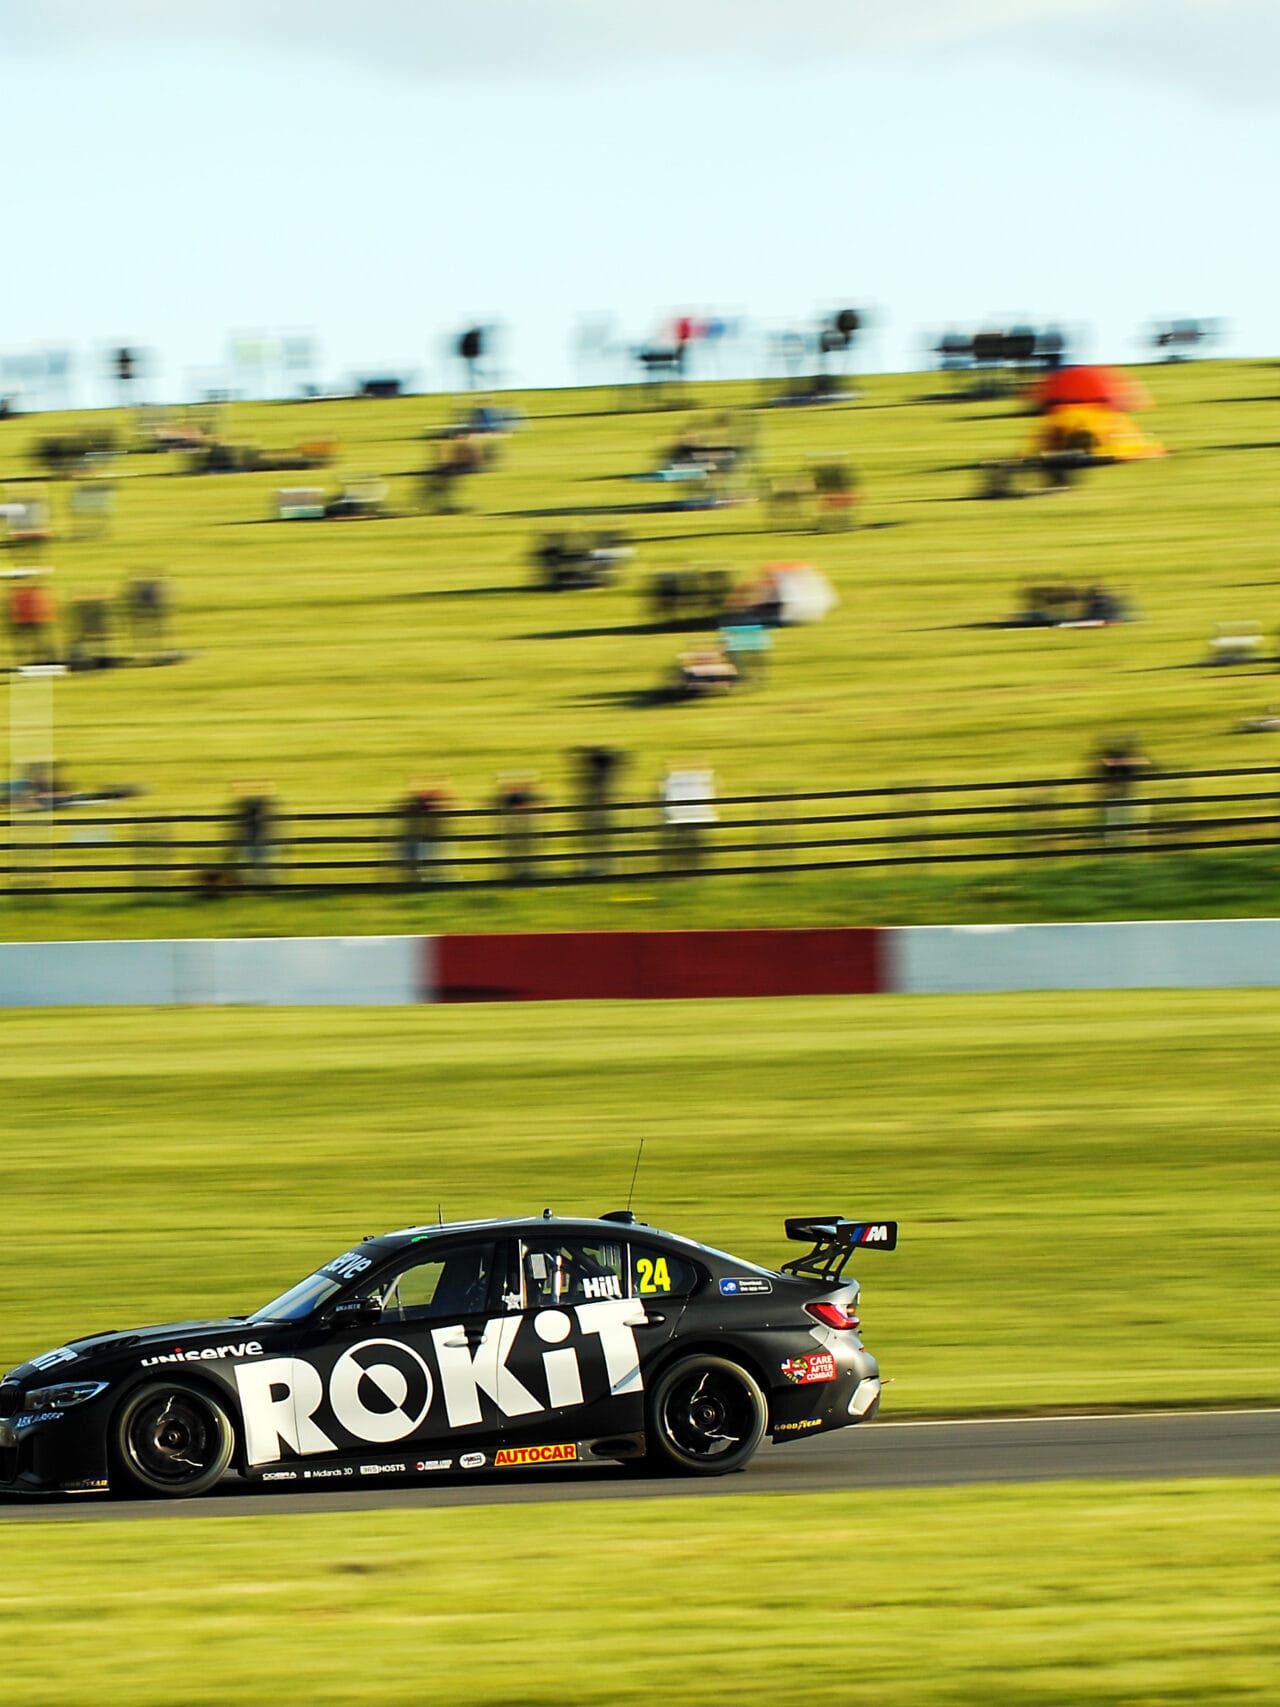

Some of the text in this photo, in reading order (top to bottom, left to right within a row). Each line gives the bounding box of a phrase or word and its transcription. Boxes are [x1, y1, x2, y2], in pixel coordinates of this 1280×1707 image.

[866, 1226, 888, 1241] M
[637, 1257, 671, 1294] 24
[583, 1275, 622, 1299] Hill
[810, 1355, 833, 1366] CARE
[811, 1364, 834, 1373] AFTER
[234, 1299, 646, 1466] ROKiT
[806, 1371, 834, 1381] COMBAT
[774, 1418, 823, 1431] GOODYEAR
[496, 1445, 575, 1465] AUTOCAR
[343, 1467, 354, 1476] 3D
